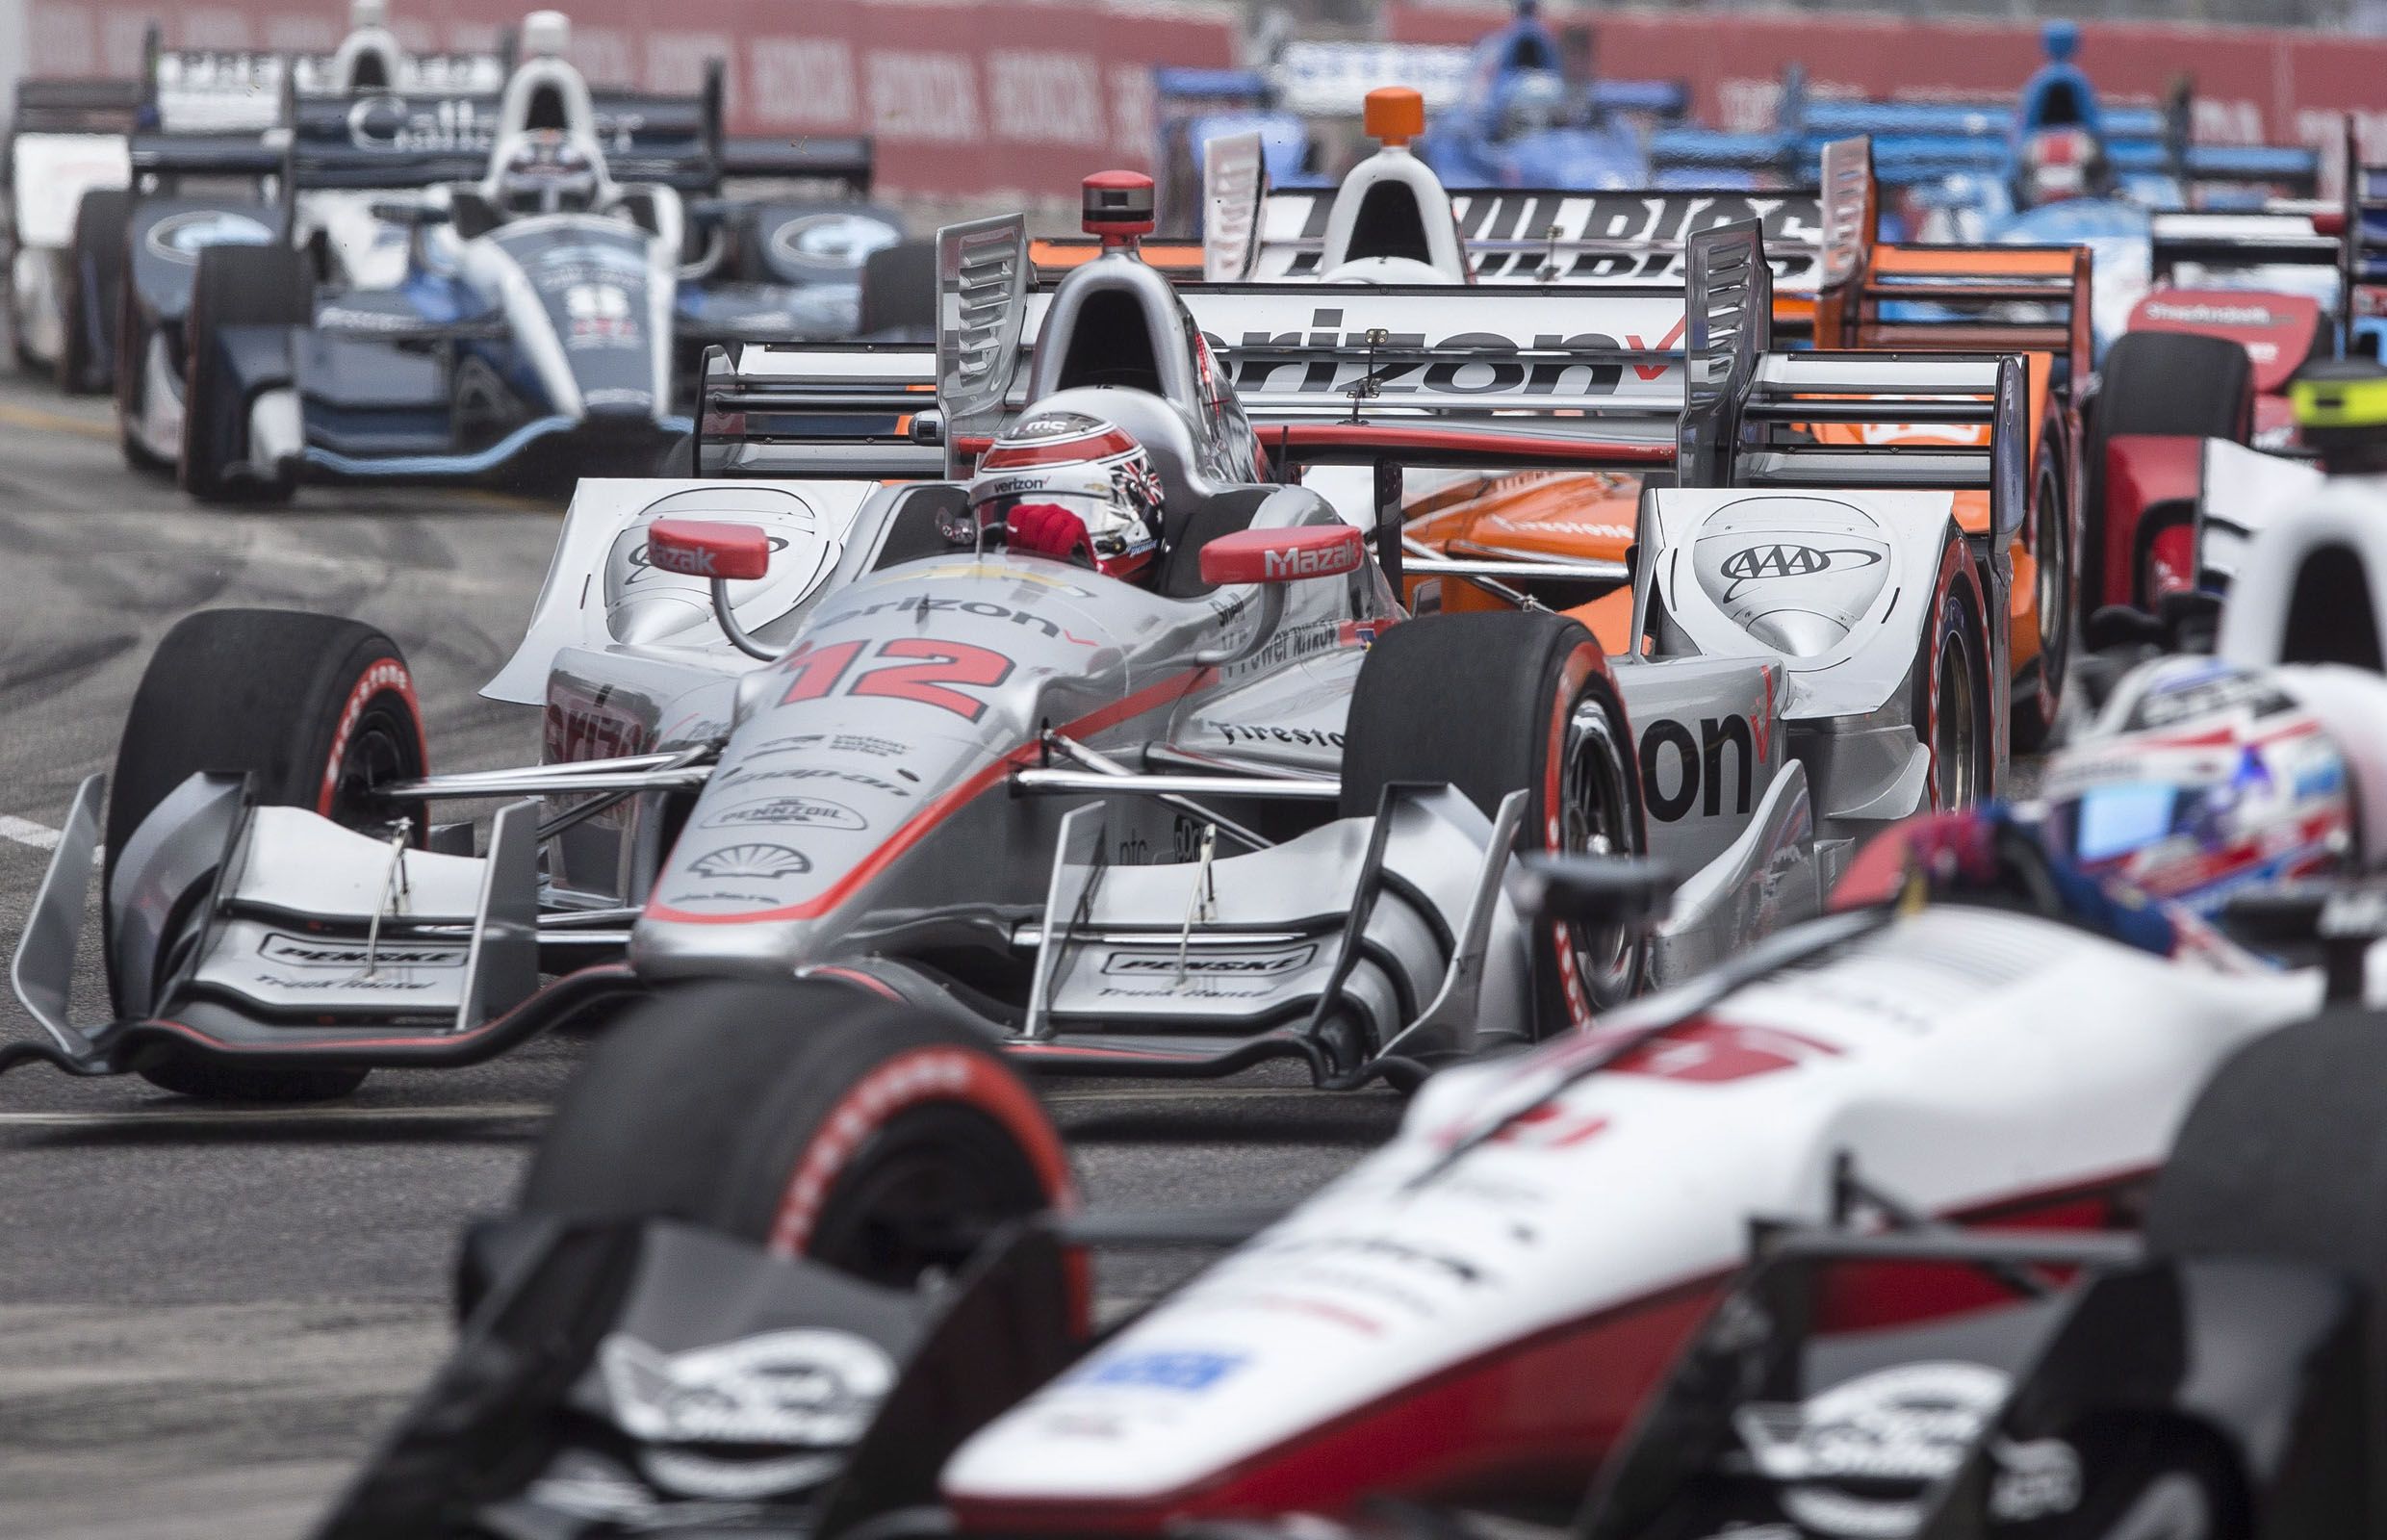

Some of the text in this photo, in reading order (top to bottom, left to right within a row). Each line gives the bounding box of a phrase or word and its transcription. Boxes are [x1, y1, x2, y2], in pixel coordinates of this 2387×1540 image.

[1201, 308, 1623, 395] rizon
[993, 476, 1043, 493] verizon
[1265, 539, 1357, 578] Mazak
[776, 636, 1016, 724] 12
[1208, 720, 1346, 749] Firesto
